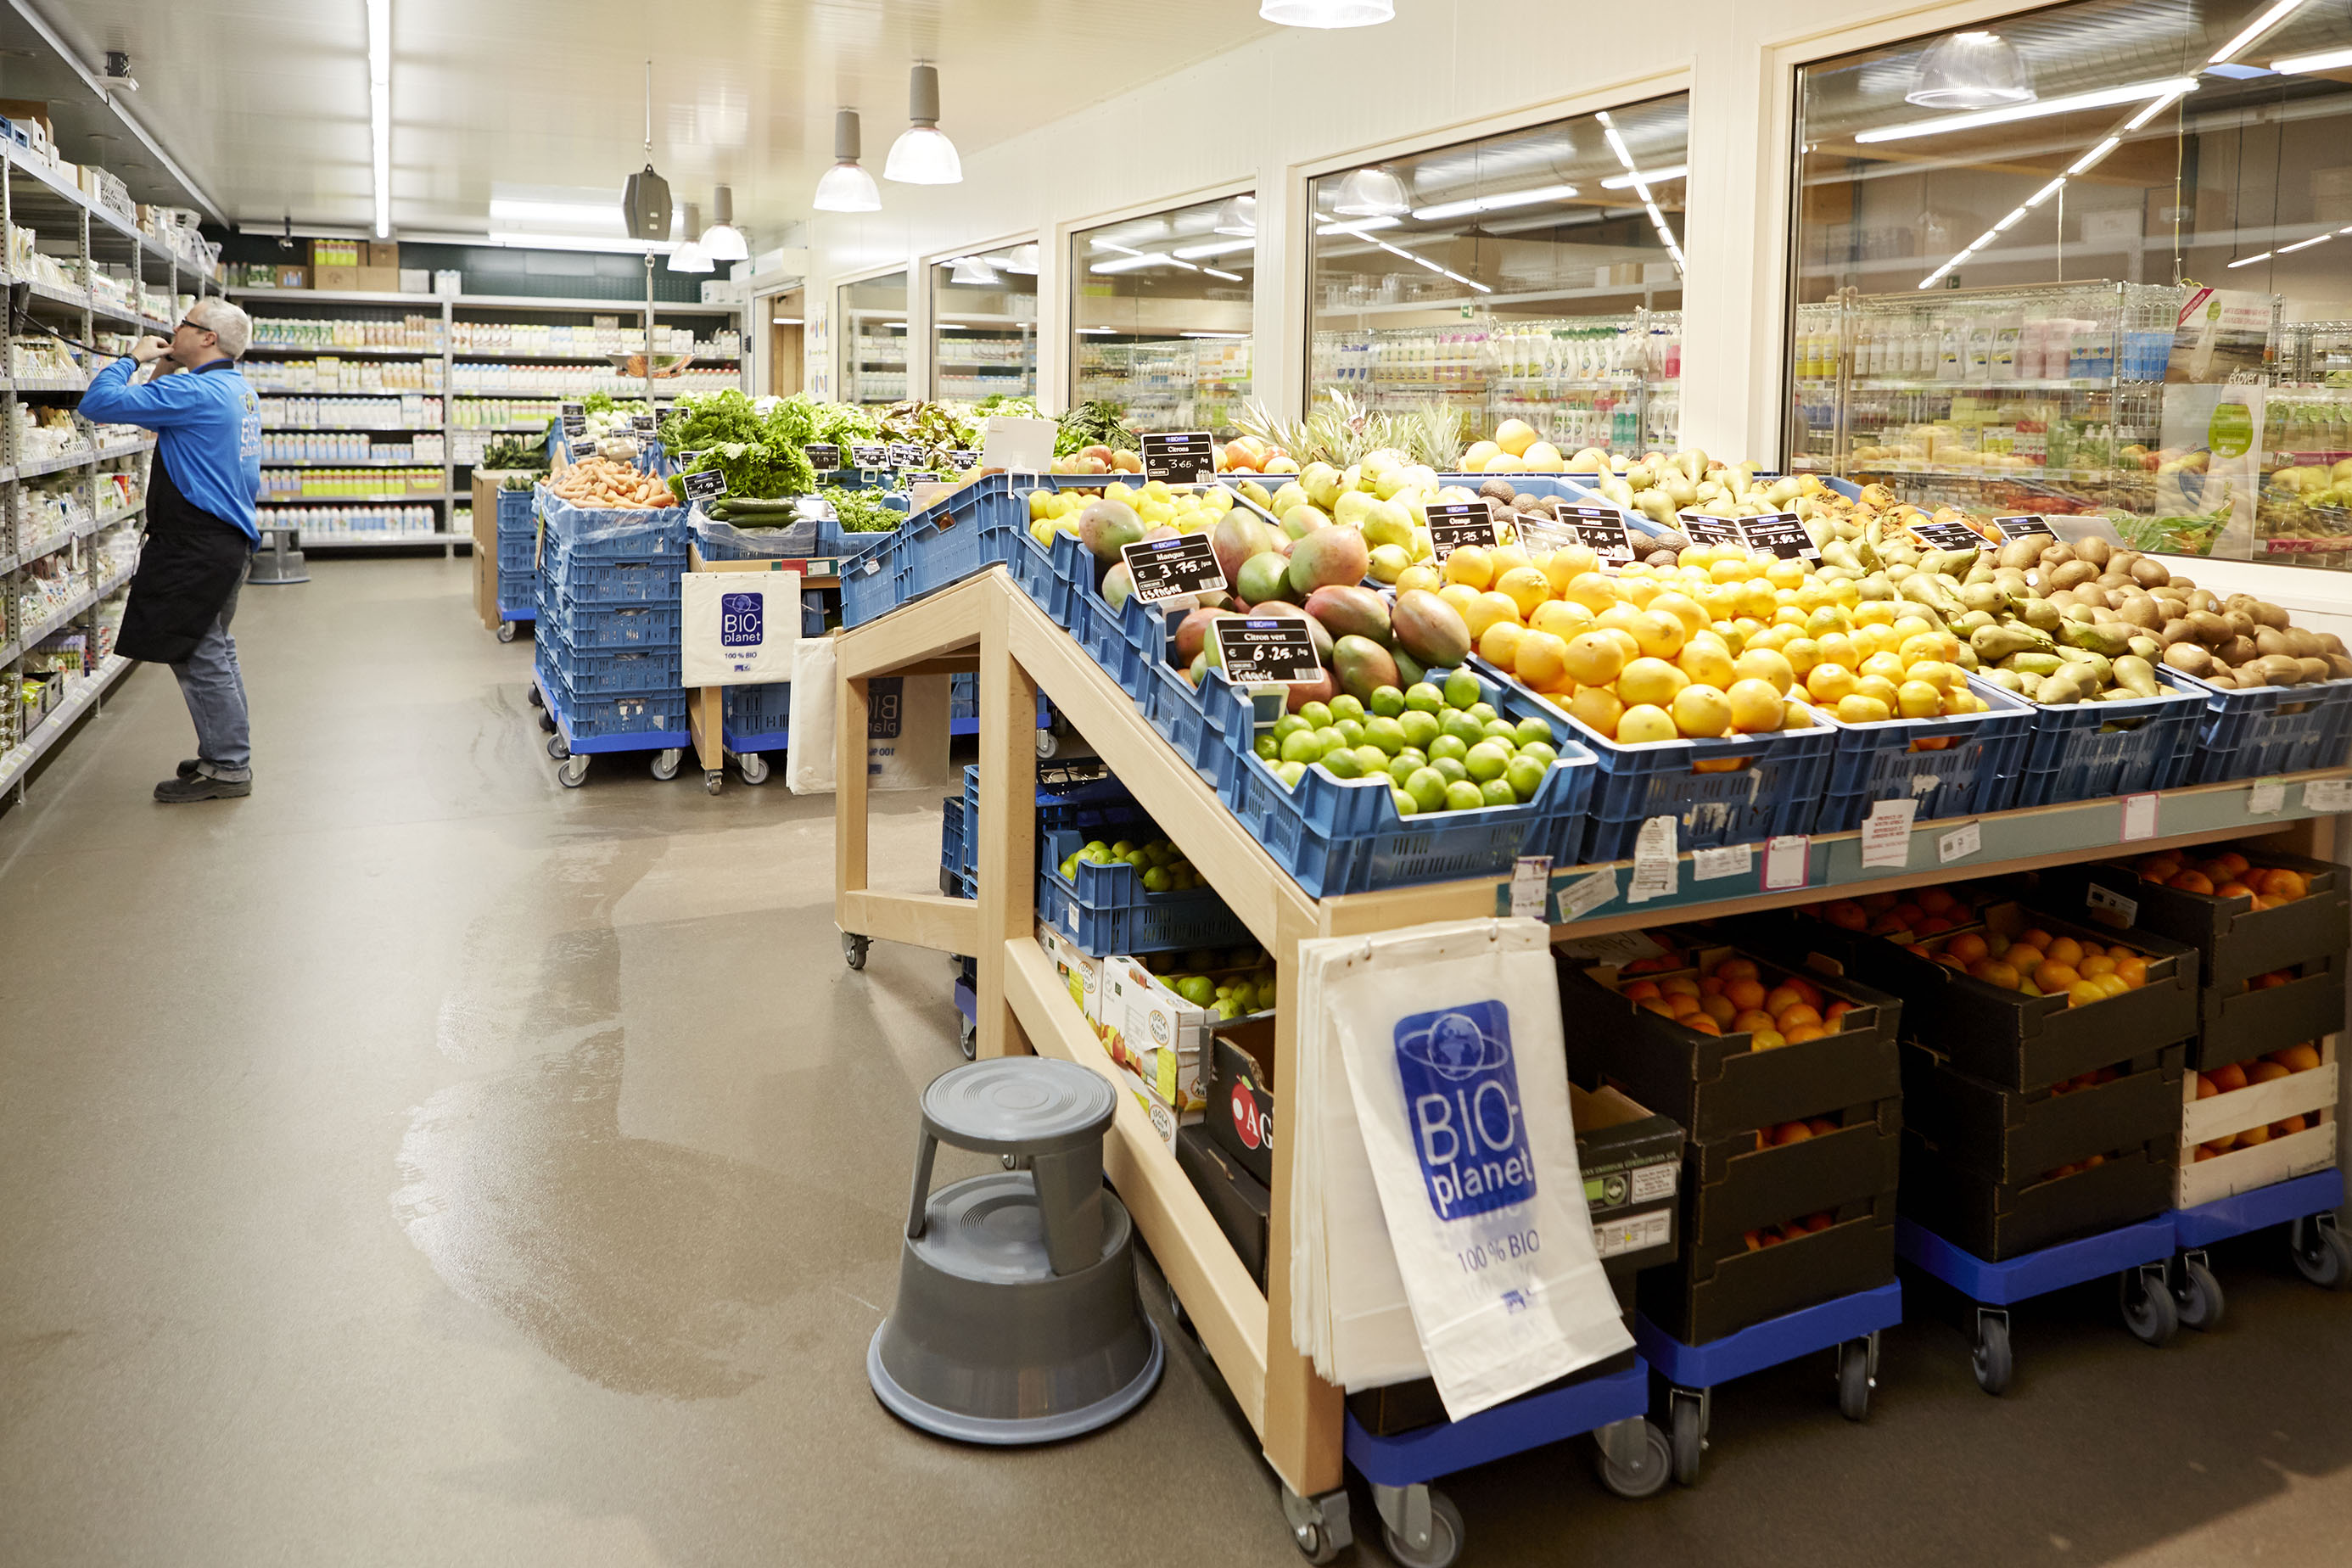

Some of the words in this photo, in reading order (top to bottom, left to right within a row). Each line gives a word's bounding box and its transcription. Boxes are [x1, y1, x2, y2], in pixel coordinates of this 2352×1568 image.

[1156, 552, 1185, 561] Mangue
[725, 632, 761, 645] planet
[1244, 633, 1269, 641] Citron
[1431, 1147, 1533, 1218] planet
[1458, 1245, 1487, 1274] 100
[1487, 1239, 1506, 1264] %
[1508, 1229, 1540, 1258] BIO
